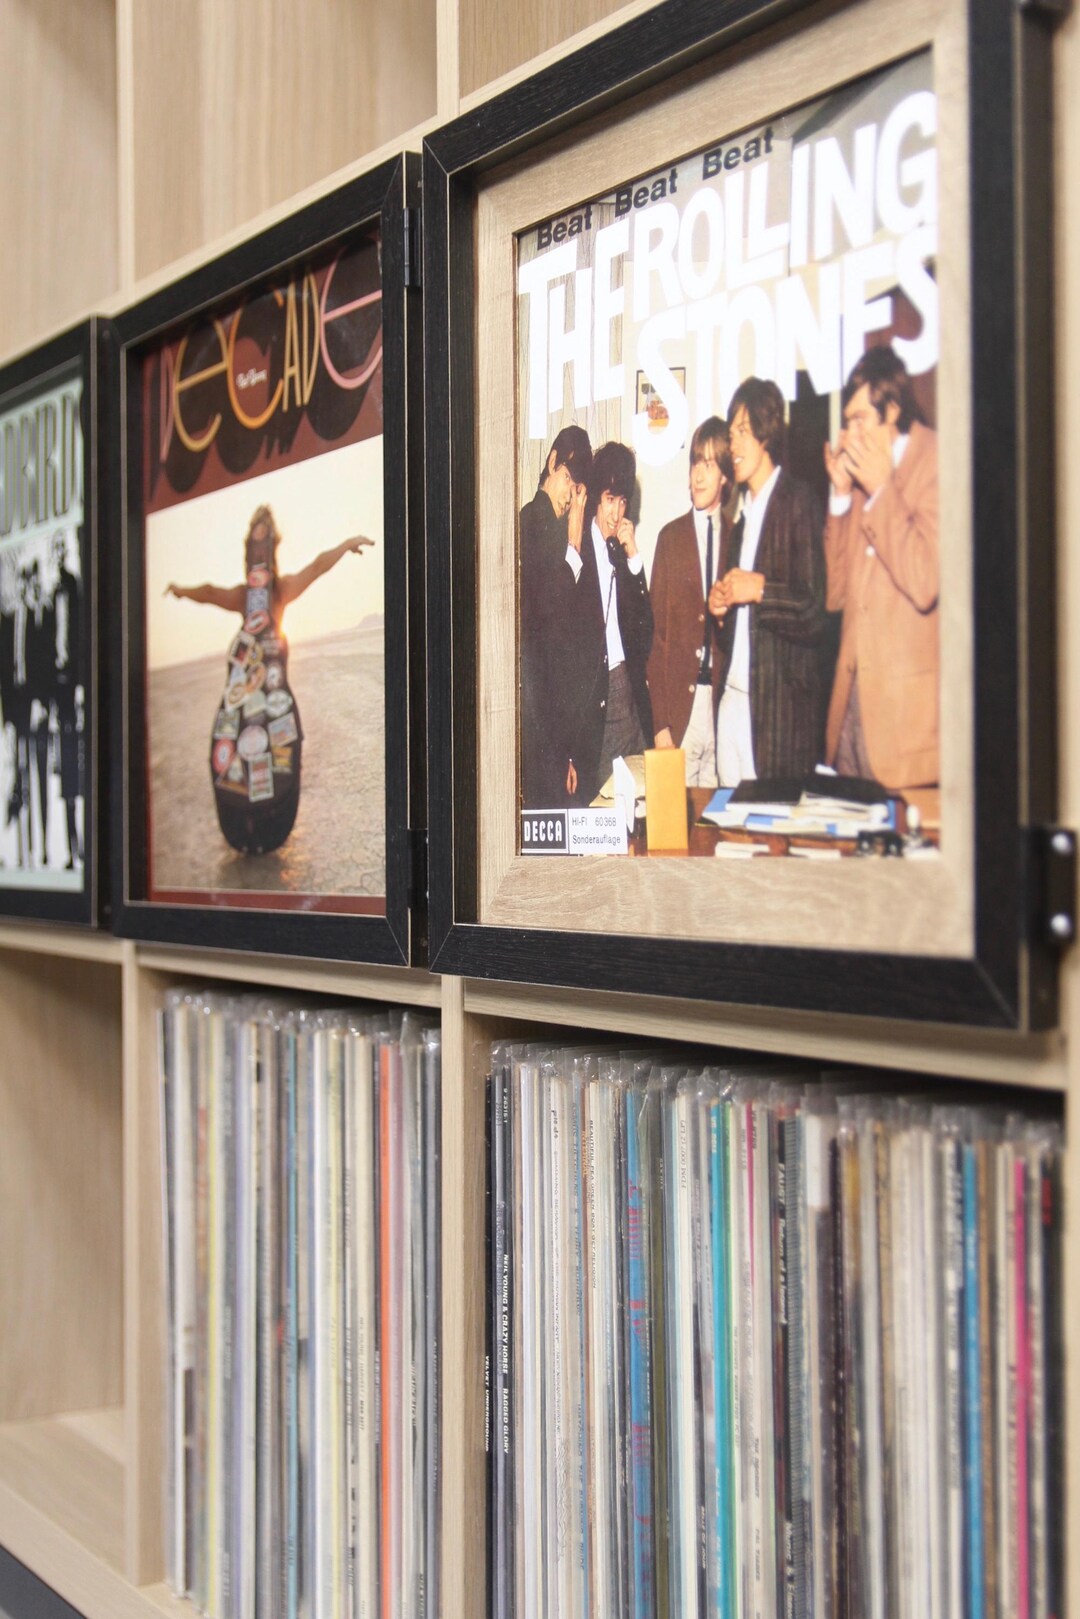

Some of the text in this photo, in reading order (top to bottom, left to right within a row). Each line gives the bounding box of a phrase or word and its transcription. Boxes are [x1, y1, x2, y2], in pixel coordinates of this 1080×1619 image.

[536, 127, 774, 251] Beat Beat Beat
[518, 91, 939, 440] THE ROLLING
[631, 224, 939, 467] STONES
[523, 820, 563, 842] DECCA
[572, 834, 621, 846] Sonderauflage
